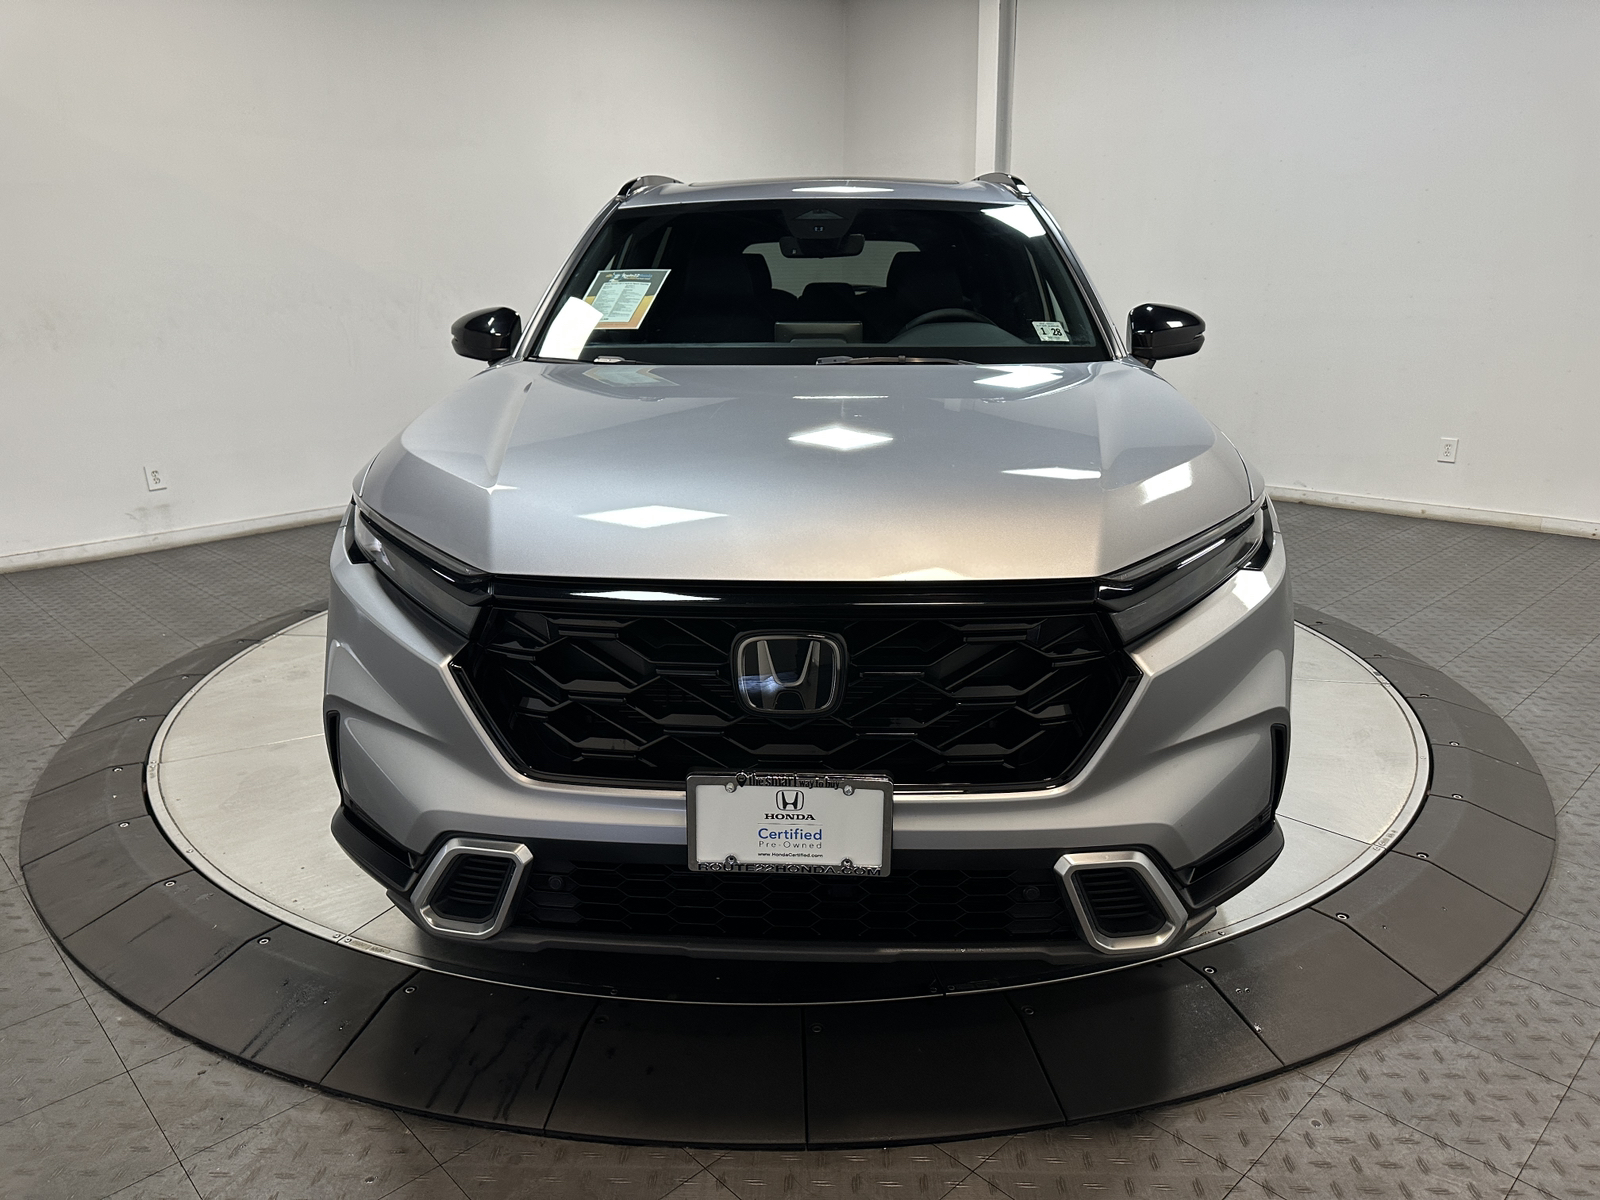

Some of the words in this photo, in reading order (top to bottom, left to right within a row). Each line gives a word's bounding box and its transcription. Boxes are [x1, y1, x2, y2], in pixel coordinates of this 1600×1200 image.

[1041, 327, 1047, 335] 1
[1051, 328, 1062, 336] 28
[764, 813, 816, 821] HONDA
[758, 828, 822, 840] Certified
[758, 840, 822, 849] Pre-Owned
[698, 862, 881, 876] ROUTE22HONDA.COM
